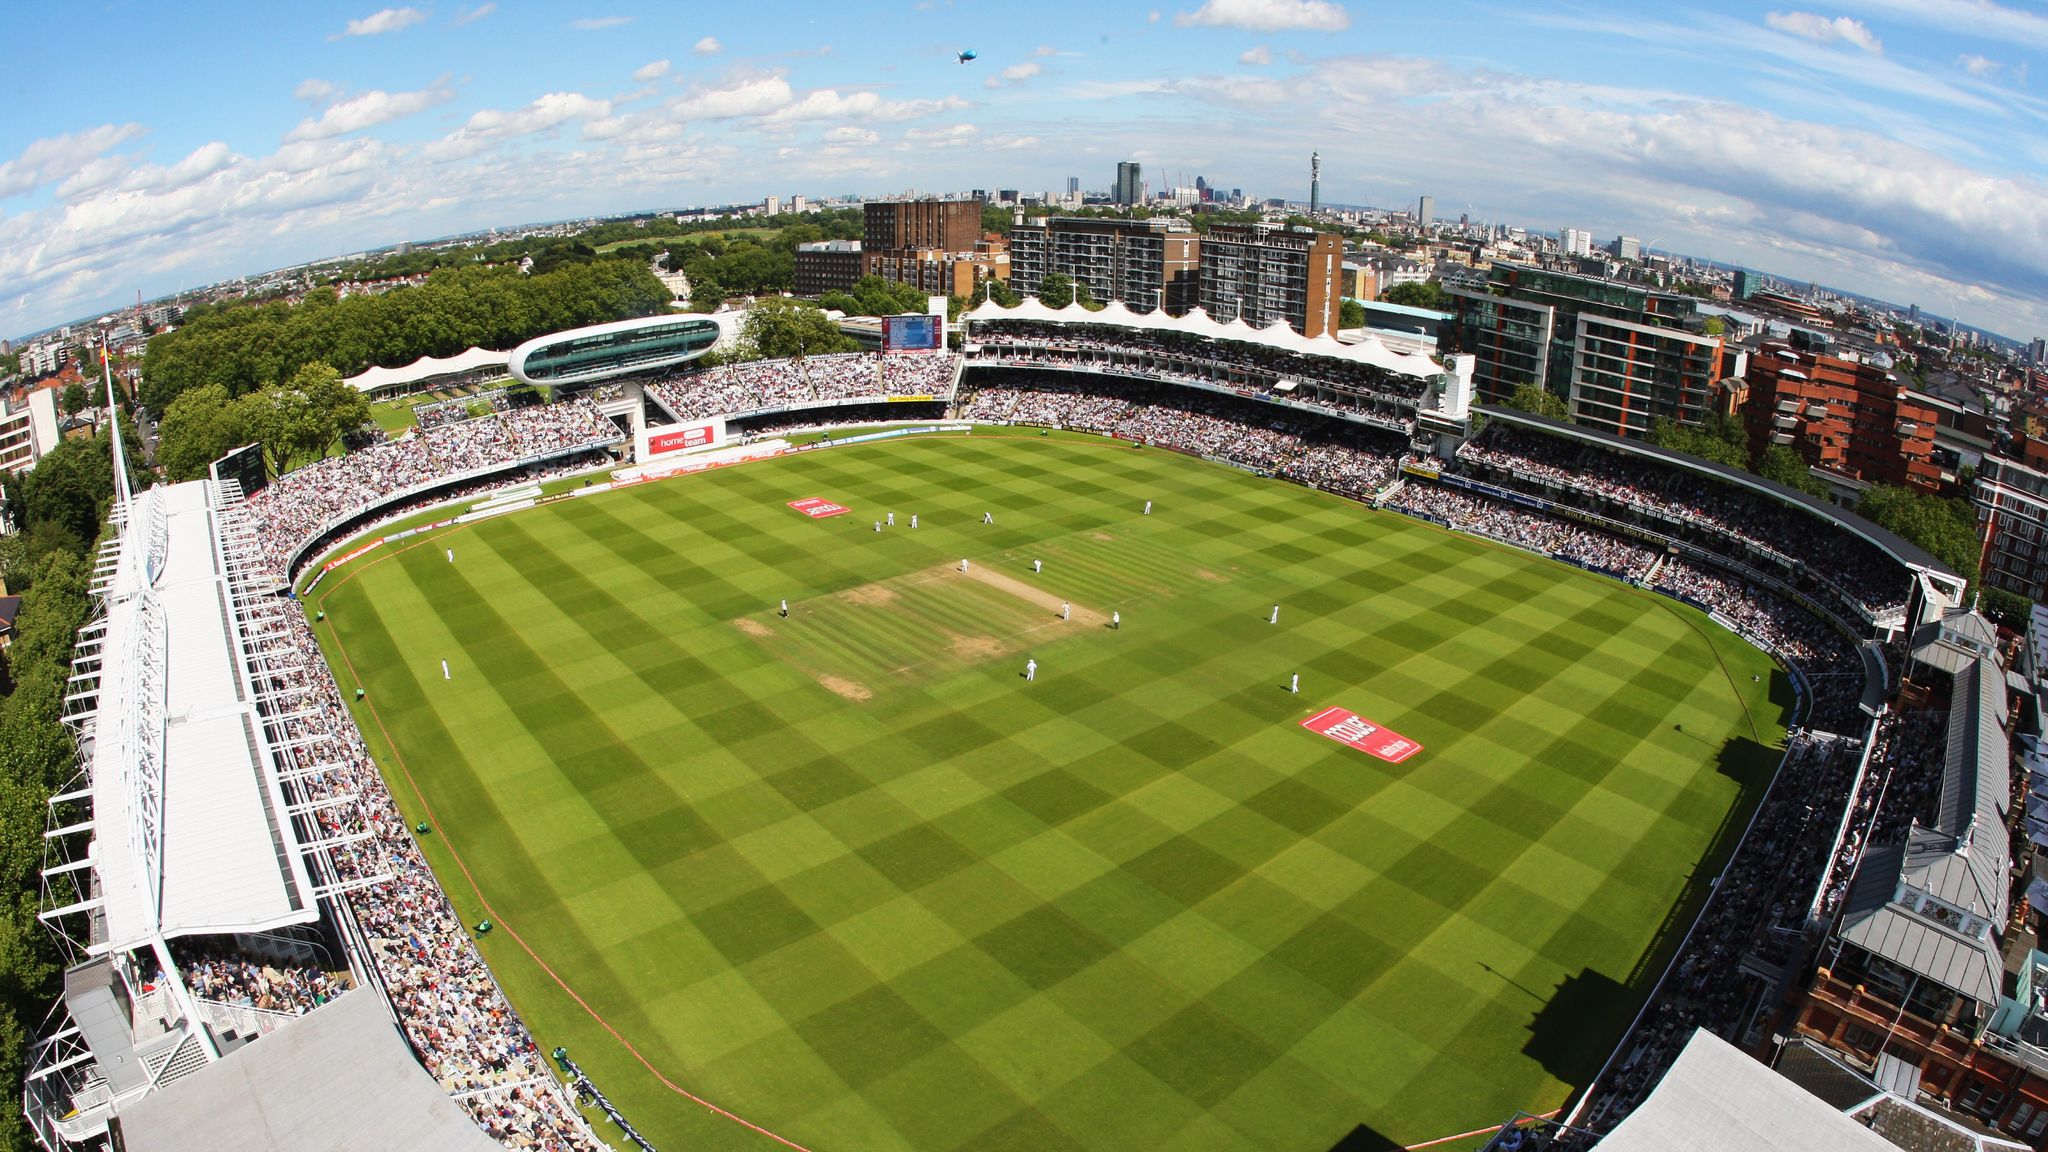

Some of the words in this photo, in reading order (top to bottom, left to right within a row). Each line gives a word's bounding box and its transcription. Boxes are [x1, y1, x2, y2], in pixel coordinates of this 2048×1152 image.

[592, 438, 622, 448] PROVIDENT
[660, 437, 683, 447] home
[684, 437, 706, 447] team
[1564, 510, 1581, 519] WOLF
[1584, 515, 1606, 527] BLASS
[1623, 527, 1641, 537] WOLF
[1643, 533, 1666, 545] BLASS
